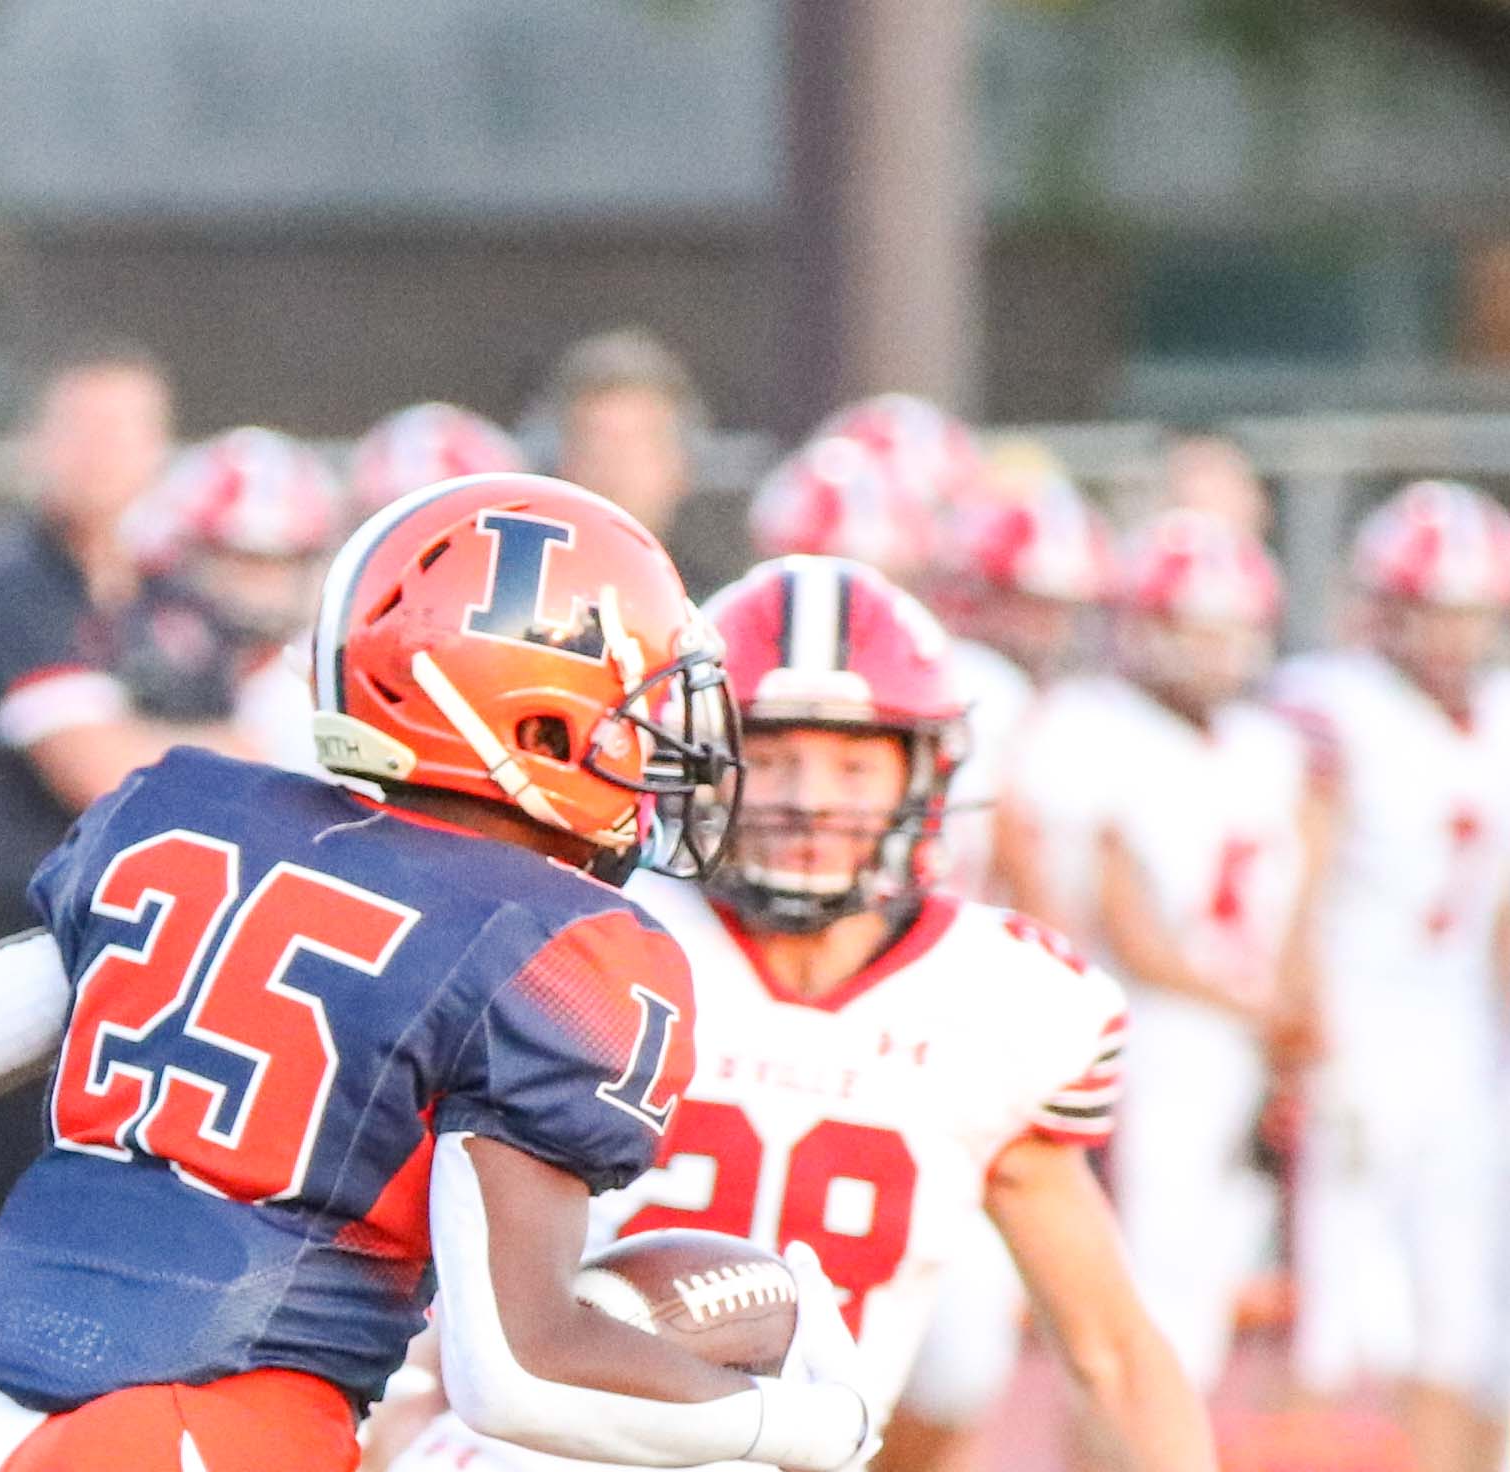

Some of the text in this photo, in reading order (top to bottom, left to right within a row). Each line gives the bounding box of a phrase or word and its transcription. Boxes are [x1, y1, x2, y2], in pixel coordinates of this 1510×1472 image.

[464, 510, 609, 664] L
[51, 829, 421, 1202] 25
[596, 984, 682, 1134] L
